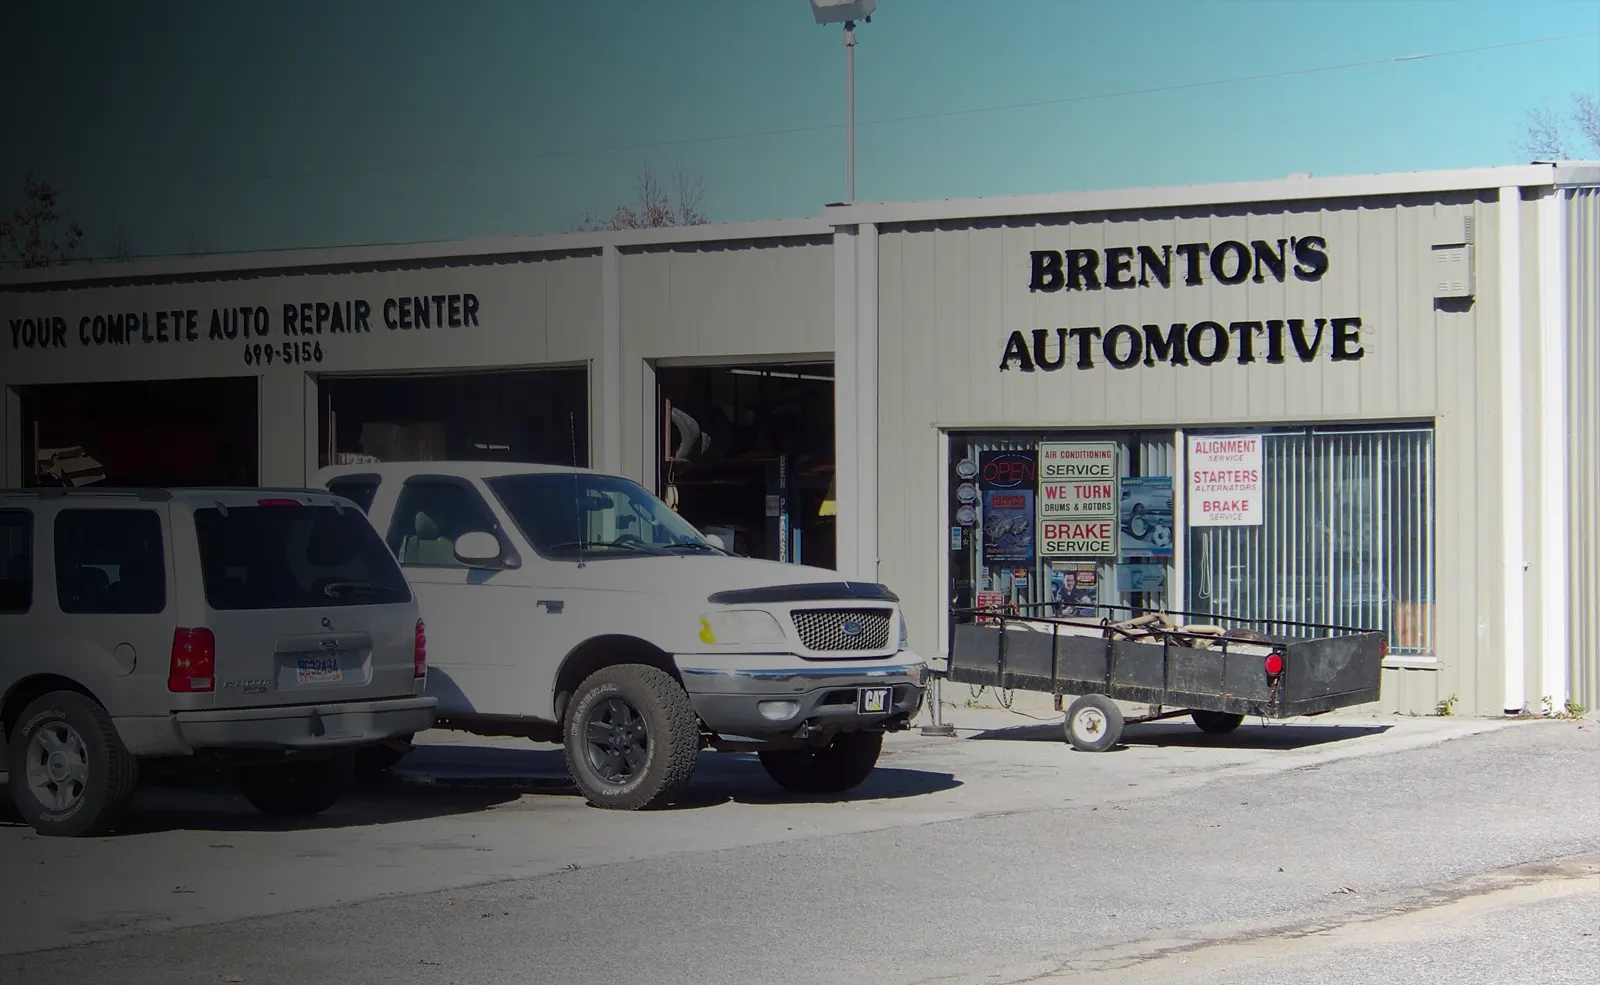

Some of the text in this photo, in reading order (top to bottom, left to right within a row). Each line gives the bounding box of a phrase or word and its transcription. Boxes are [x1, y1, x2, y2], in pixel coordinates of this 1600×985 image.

[1029, 235, 1329, 293] BRENTON'S
[9, 293, 480, 349] YOUR COMPLETE AUTO REPAIR CENTER
[1000, 316, 1365, 372] AUTOMOTIVE
[243, 341, 324, 366] 699-5156
[1195, 440, 1256, 454] ALIGNMENT
[1045, 450, 1112, 459] AIR CONDITIONING
[1208, 454, 1245, 462] SERVICE
[983, 462, 1035, 481] OPEN
[1046, 464, 1110, 476] SERVICE
[1194, 470, 1258, 483] STARTERS
[1045, 484, 1112, 500] WE TURN
[1195, 484, 1256, 492] ALTERNATORS
[1044, 502, 1112, 512] DRUMS & ROTORS
[1203, 500, 1250, 513] BRAKE
[1209, 512, 1243, 521] SERVICE
[1044, 523, 1112, 540] BRAKE
[1046, 540, 1111, 552] SERVICE
[865, 690, 888, 711] CAT
